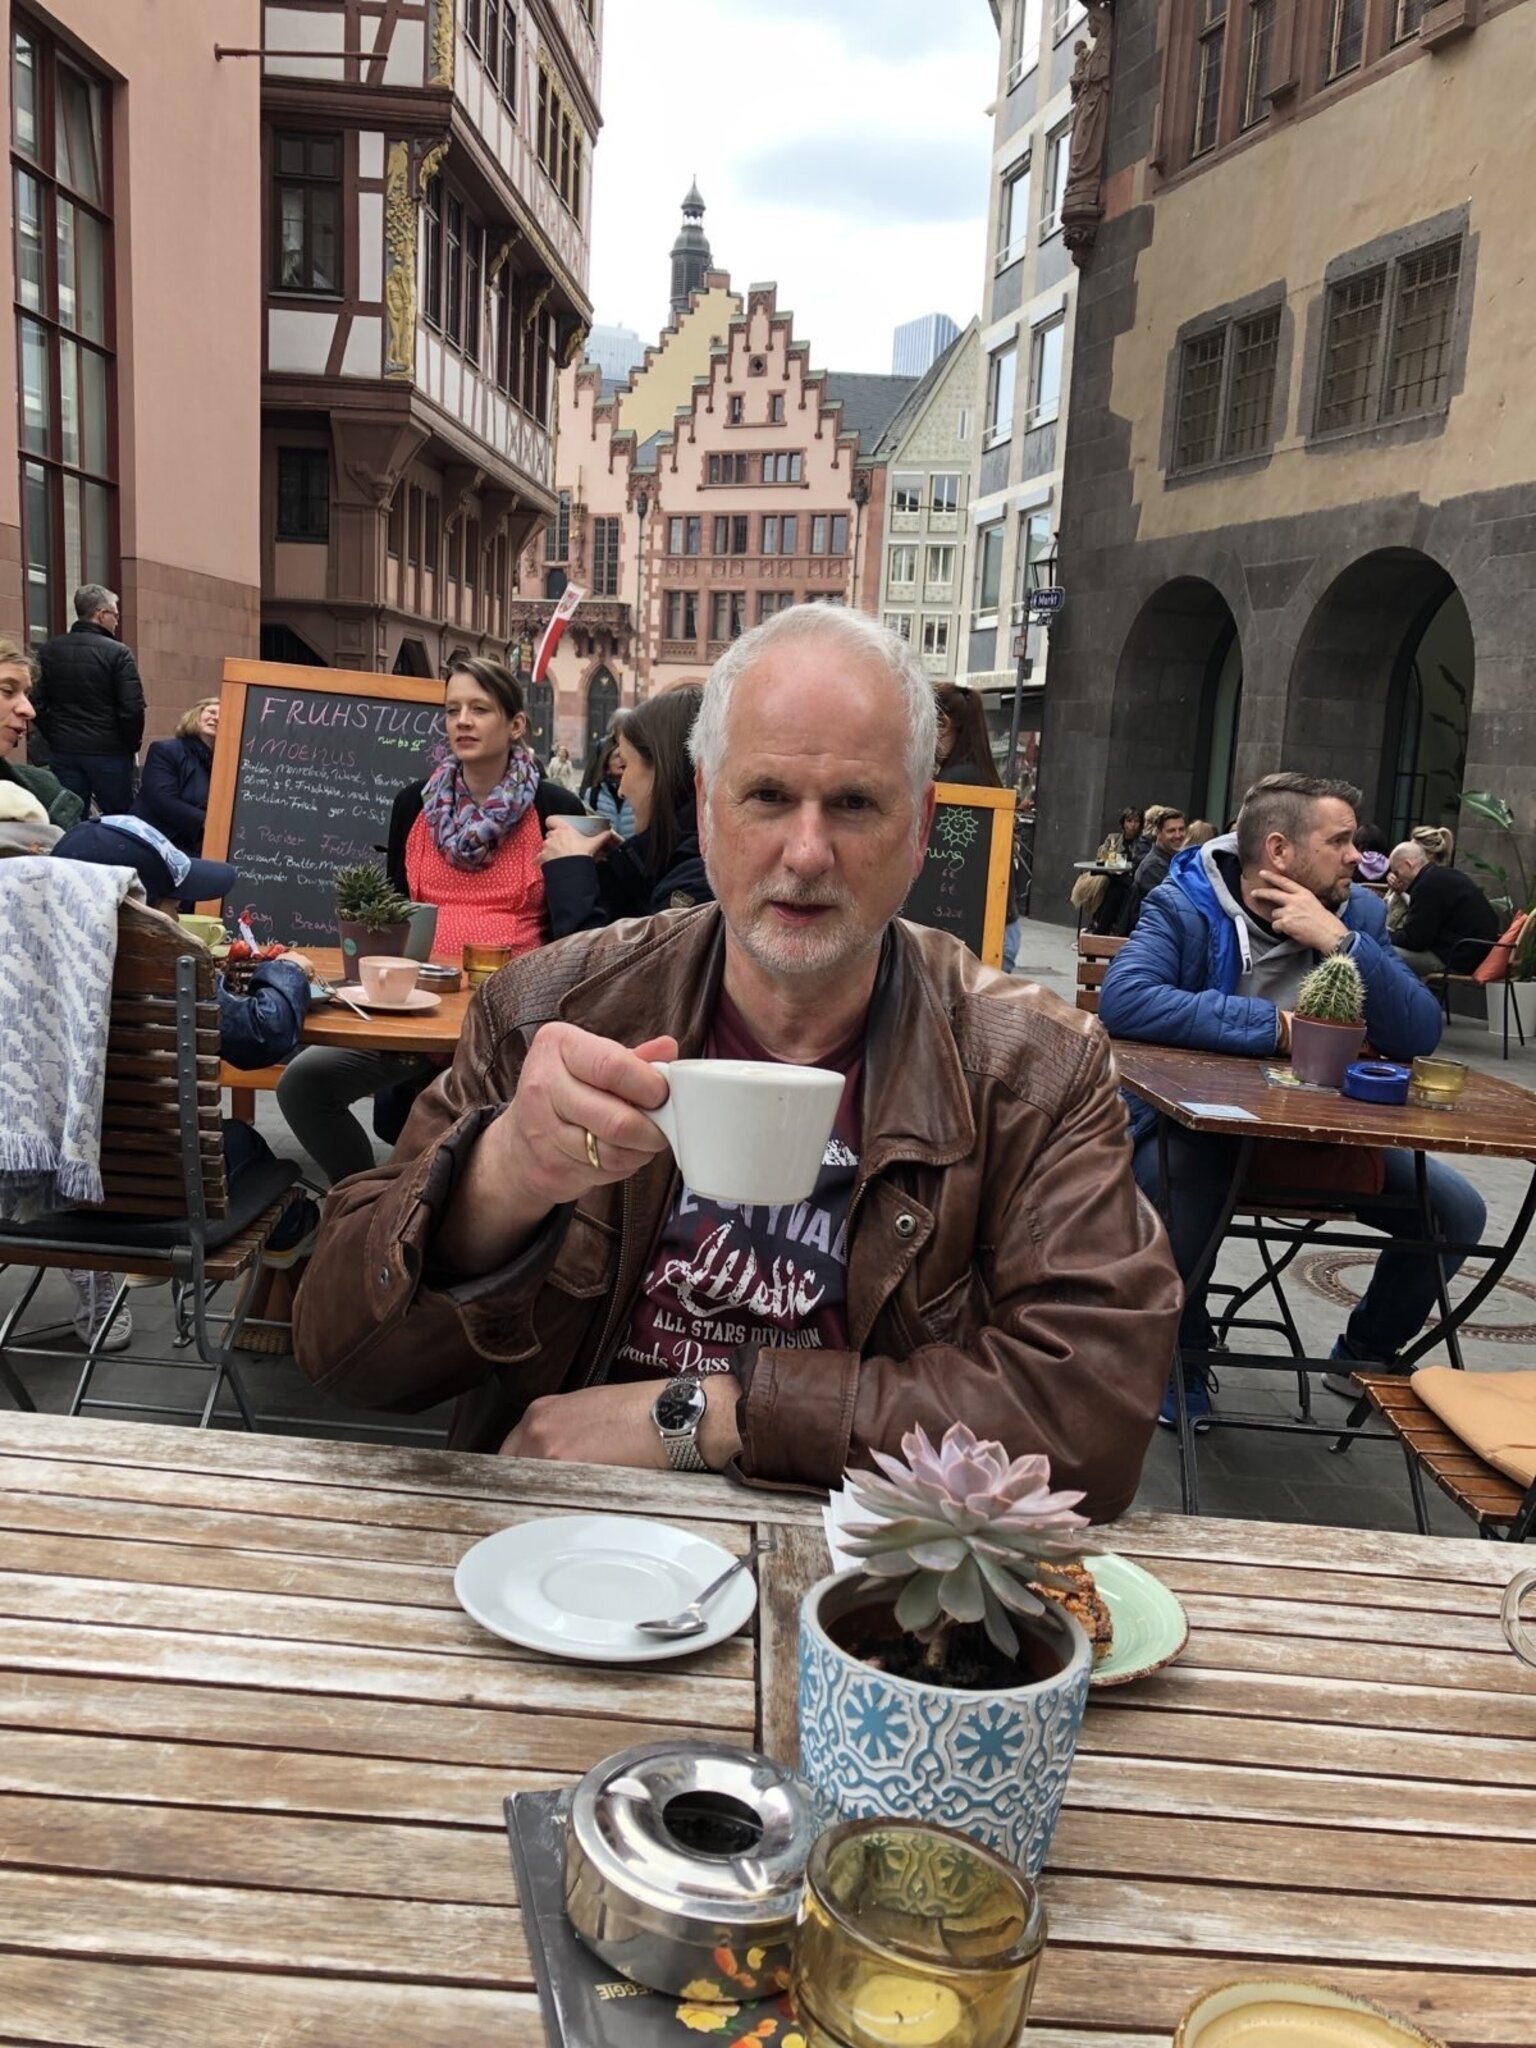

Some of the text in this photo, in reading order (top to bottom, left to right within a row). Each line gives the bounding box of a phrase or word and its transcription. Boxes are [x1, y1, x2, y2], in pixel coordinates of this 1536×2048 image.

[1038, 593, 1058, 605] Markt
[653, 1308, 823, 1350] ALL STARS DIVISION
[672, 1338, 730, 1372] Pass
